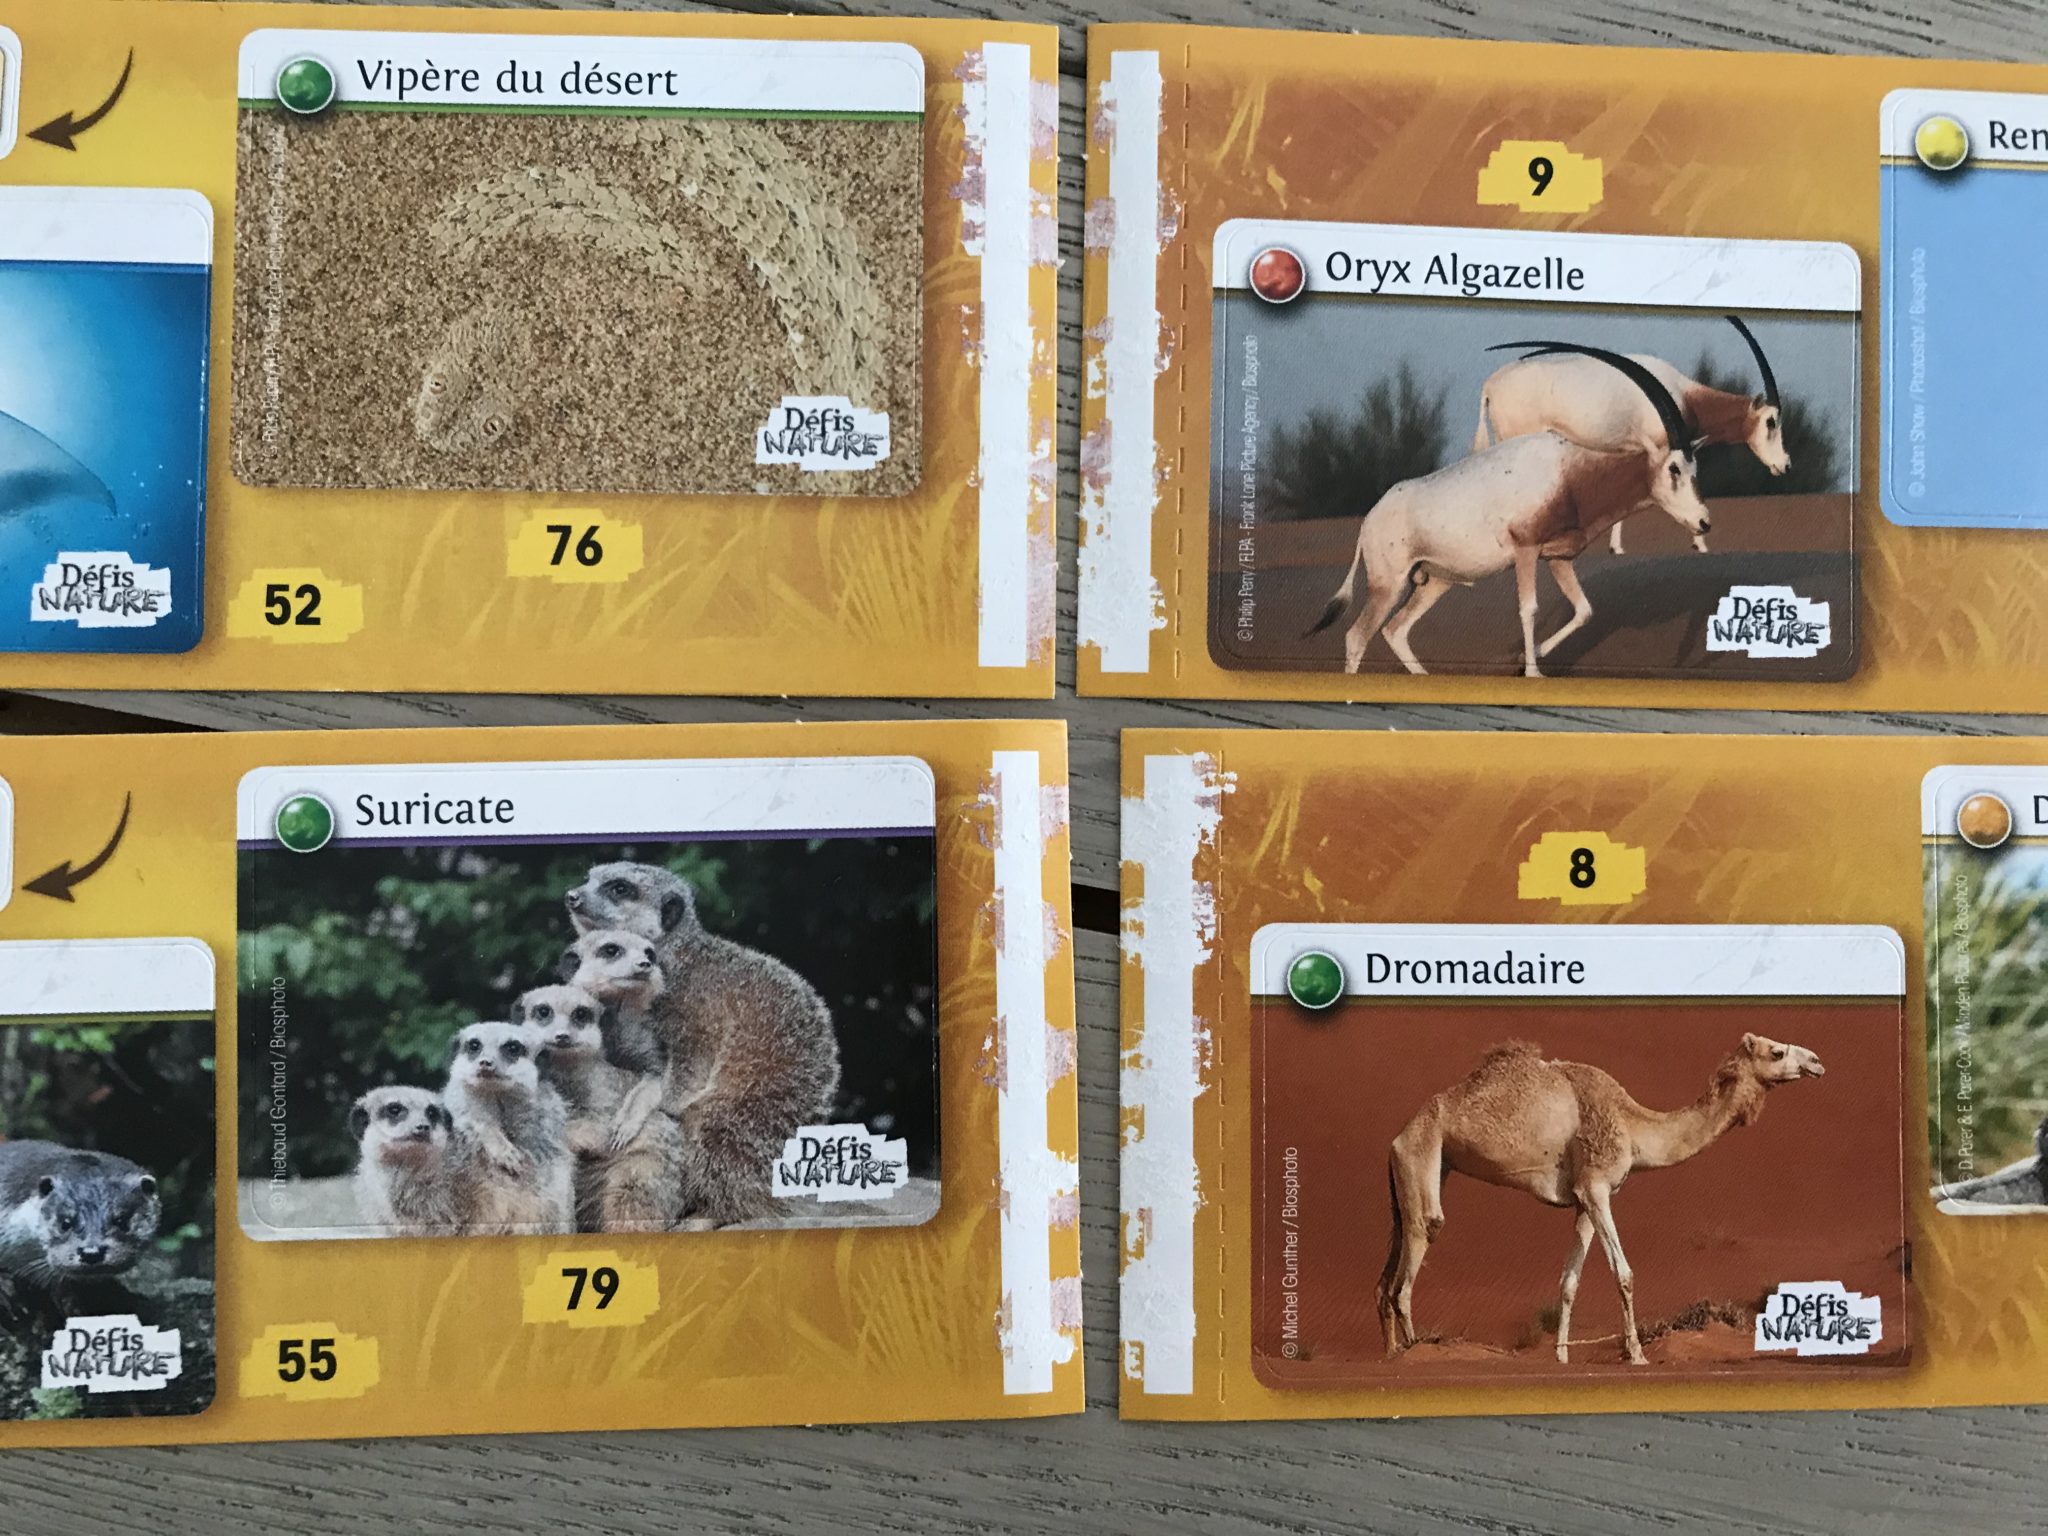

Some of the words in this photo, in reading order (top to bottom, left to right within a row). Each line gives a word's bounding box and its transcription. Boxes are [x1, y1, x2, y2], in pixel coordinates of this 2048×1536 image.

[356, 59, 480, 101] Vipère
[496, 60, 544, 94] du
[560, 61, 679, 96] désert
[1528, 156, 1554, 197] 9
[1326, 251, 1411, 294] Oryx
[1424, 252, 1584, 296] Algazelle
[1910, 248, 1928, 314] Biosphoto
[1910, 325, 1925, 392] Photoshot
[785, 407, 855, 437] Défis
[1241, 395, 1259, 433] Agency
[1909, 404, 1925, 442] Shaw
[764, 429, 887, 460] NATURE
[1240, 436, 1256, 471] Picture
[1909, 444, 1925, 480] John
[1241, 473, 1255, 499] Lane
[1239, 501, 1254, 529] Frank
[547, 524, 603, 567] 76
[1238, 538, 1254, 562] FLPA
[61, 563, 135, 593] Défis
[38, 585, 169, 617] NATURE
[264, 583, 321, 626] 52
[1733, 597, 1798, 625] Défis
[1713, 618, 1828, 648] NATURE
[356, 792, 516, 828] Suricate
[1569, 847, 1596, 889] 8
[1953, 875, 1970, 930] Biosphoto
[1366, 950, 1586, 986] Dromadaire
[270, 977, 289, 1048] Biosphoto
[270, 1061, 286, 1119] Gontard
[269, 1123, 286, 1190] Thiebaud
[799, 1136, 872, 1165] Défis
[779, 1160, 904, 1189] NATURE
[1282, 1147, 1300, 1217] Biosphoto
[1282, 1230, 1298, 1287] Gunther
[561, 1266, 620, 1311] 79
[1282, 1292, 1298, 1339] Michel
[1780, 1293, 1848, 1322] Défis
[68, 1327, 144, 1358] Défis
[1762, 1315, 1880, 1345] NATURE
[48, 1351, 178, 1381] NATURE
[278, 1338, 338, 1383] 55
